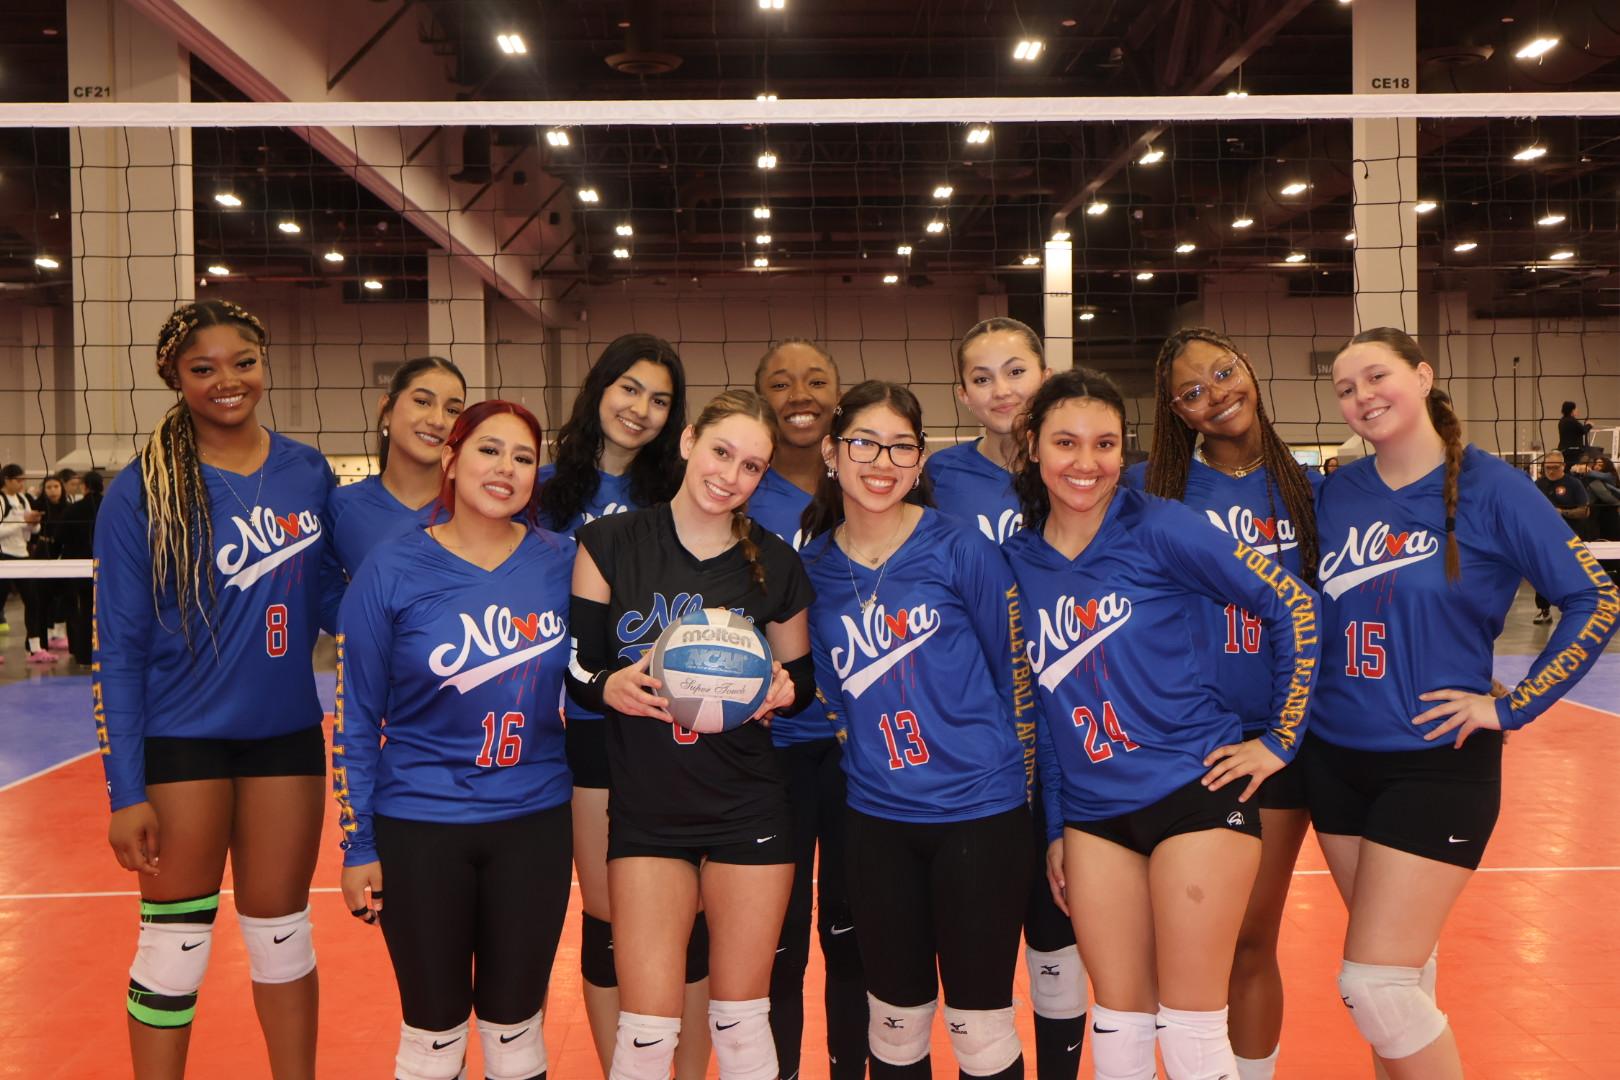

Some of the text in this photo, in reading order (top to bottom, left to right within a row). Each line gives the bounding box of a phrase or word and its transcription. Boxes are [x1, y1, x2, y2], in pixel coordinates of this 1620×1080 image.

[73, 86, 110, 98] CF21
[1371, 77, 1410, 89] CE18
[1566, 535, 1620, 644] VOLLYBALL
[265, 603, 288, 658] 8
[682, 628, 752, 648] molten
[1344, 620, 1387, 680] 15
[680, 677, 747, 696] Super Touch
[475, 711, 525, 768] 16
[878, 709, 930, 771] 13
[1071, 700, 1141, 764] 24
